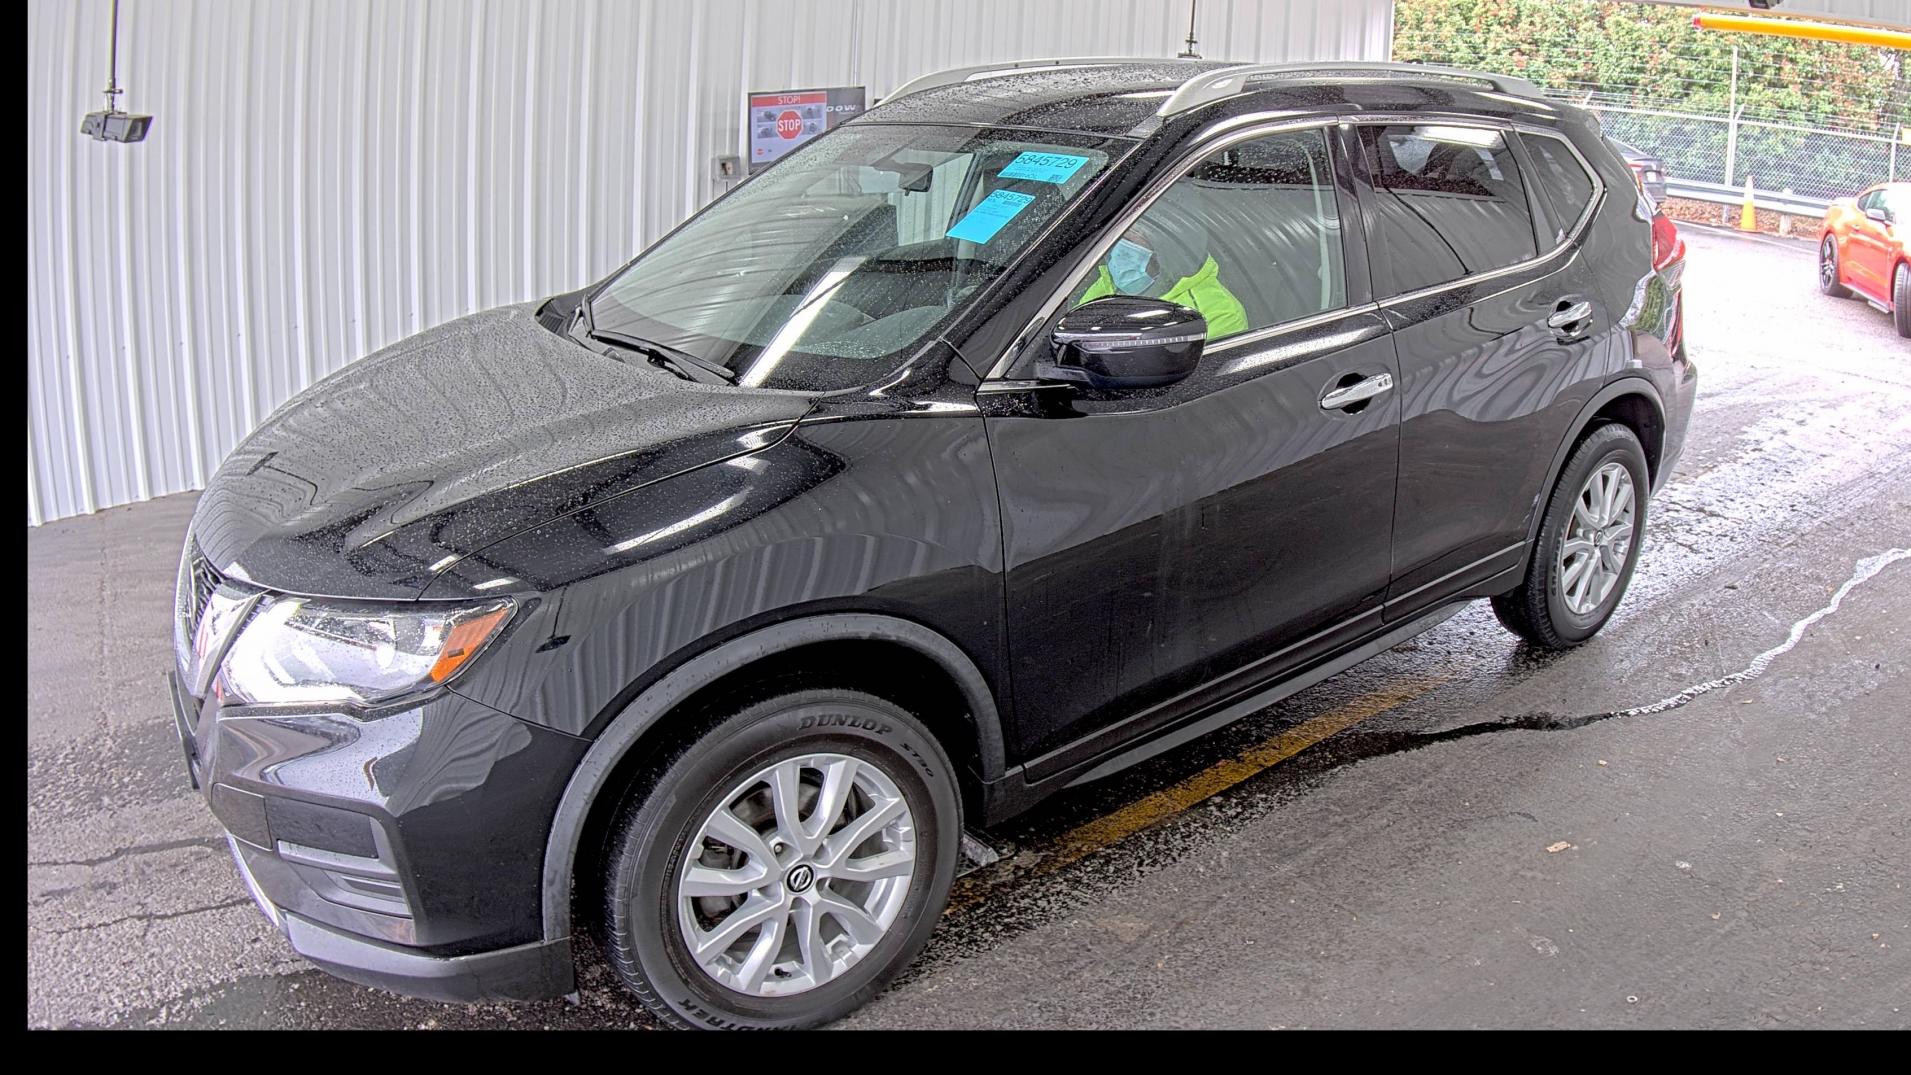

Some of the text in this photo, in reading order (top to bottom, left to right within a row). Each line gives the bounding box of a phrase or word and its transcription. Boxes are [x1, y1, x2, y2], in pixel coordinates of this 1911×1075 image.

[778, 119, 801, 132] STOP
[1014, 154, 1078, 169] 5845729
[799, 714, 894, 735] DUNLOP
